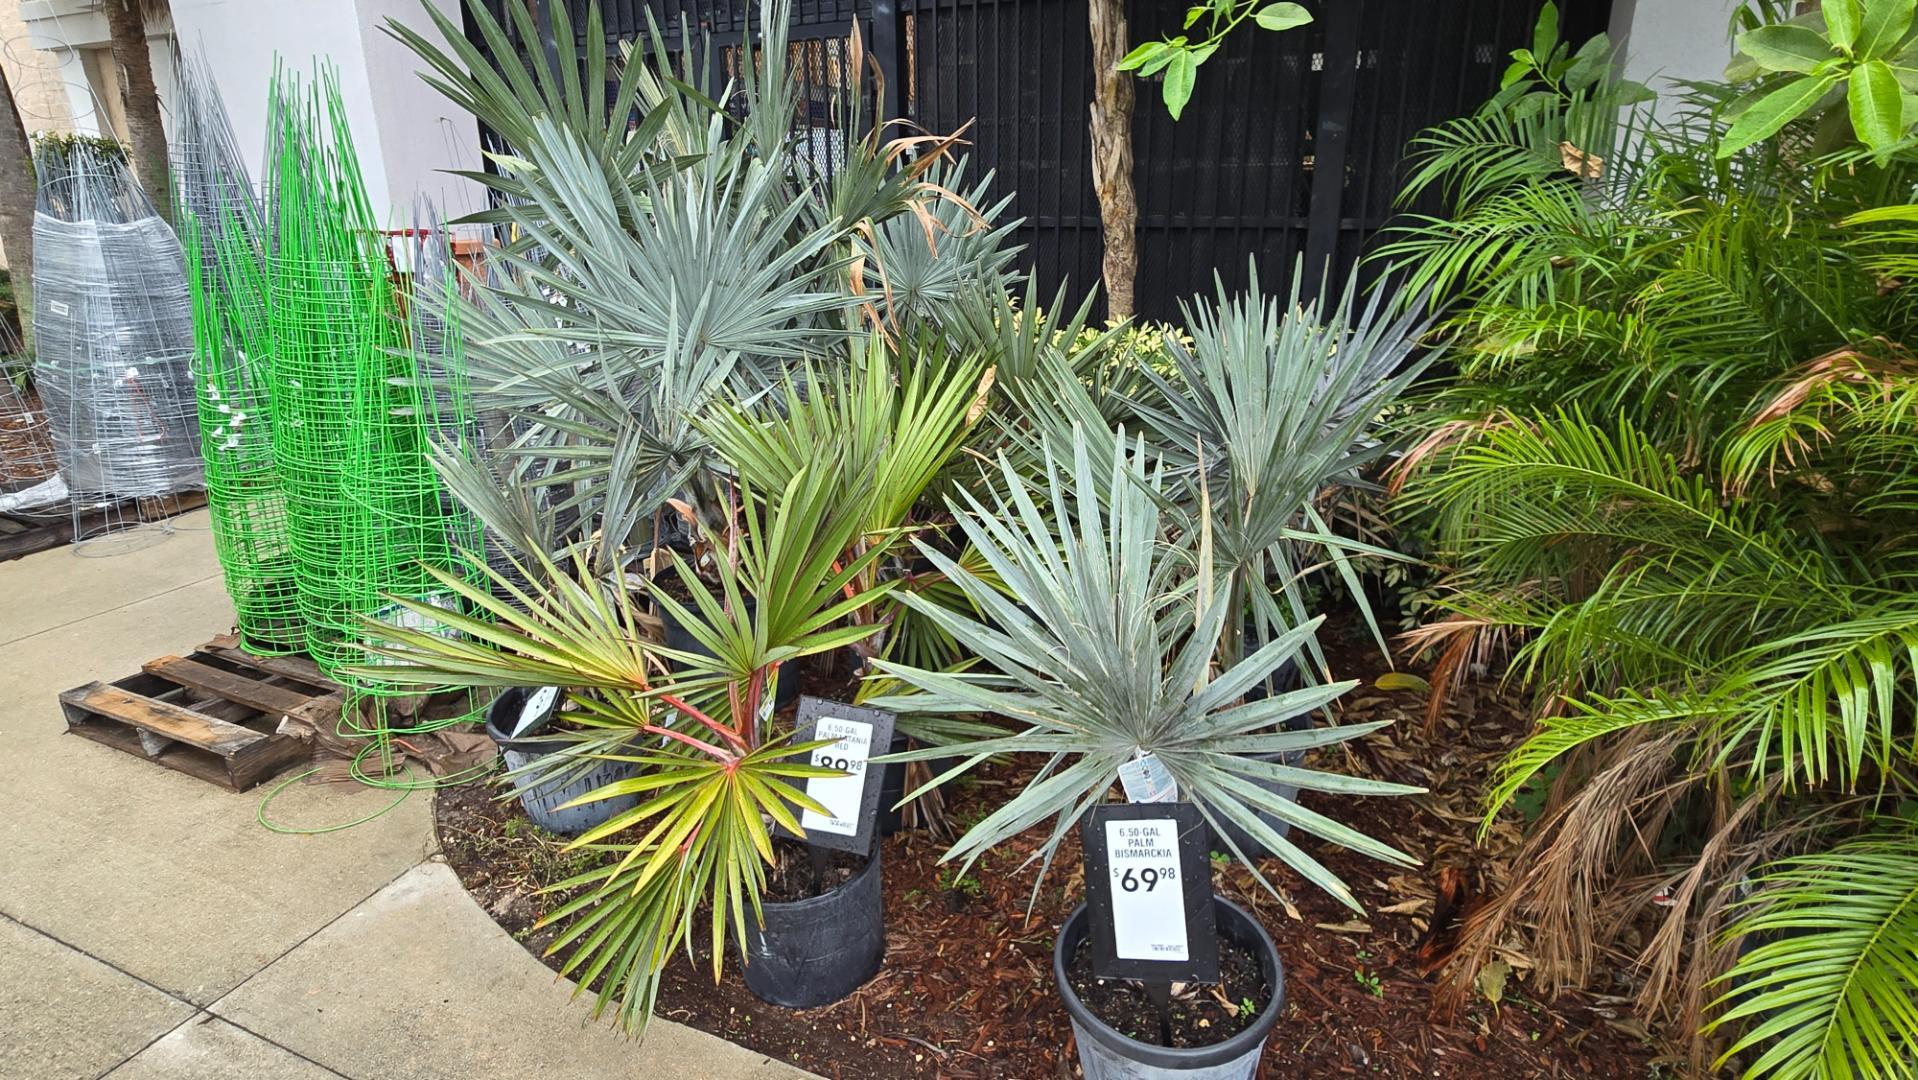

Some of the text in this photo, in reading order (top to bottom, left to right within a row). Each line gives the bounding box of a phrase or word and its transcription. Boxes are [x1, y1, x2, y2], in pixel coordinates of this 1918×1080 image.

[1119, 827, 1161, 837] 6.50-GAL
[1127, 838, 1155, 848] PALM
[1114, 849, 1172, 858] BISMARCKIA
